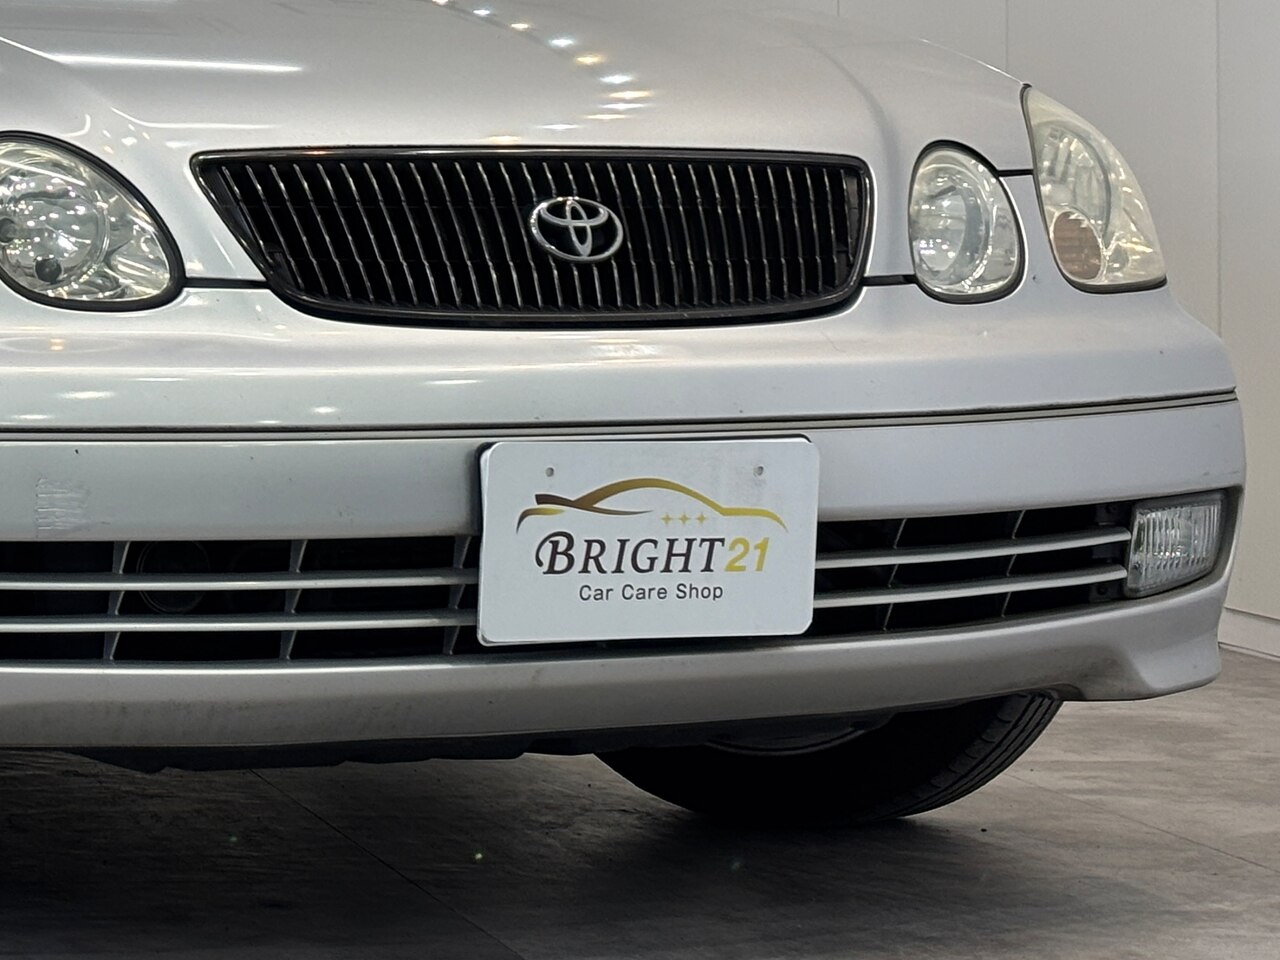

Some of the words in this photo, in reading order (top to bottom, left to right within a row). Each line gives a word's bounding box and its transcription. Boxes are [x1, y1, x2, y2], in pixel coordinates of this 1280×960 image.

[579, 585, 614, 601] Car
[621, 584, 668, 601] Care
[676, 583, 723, 601] Shop
